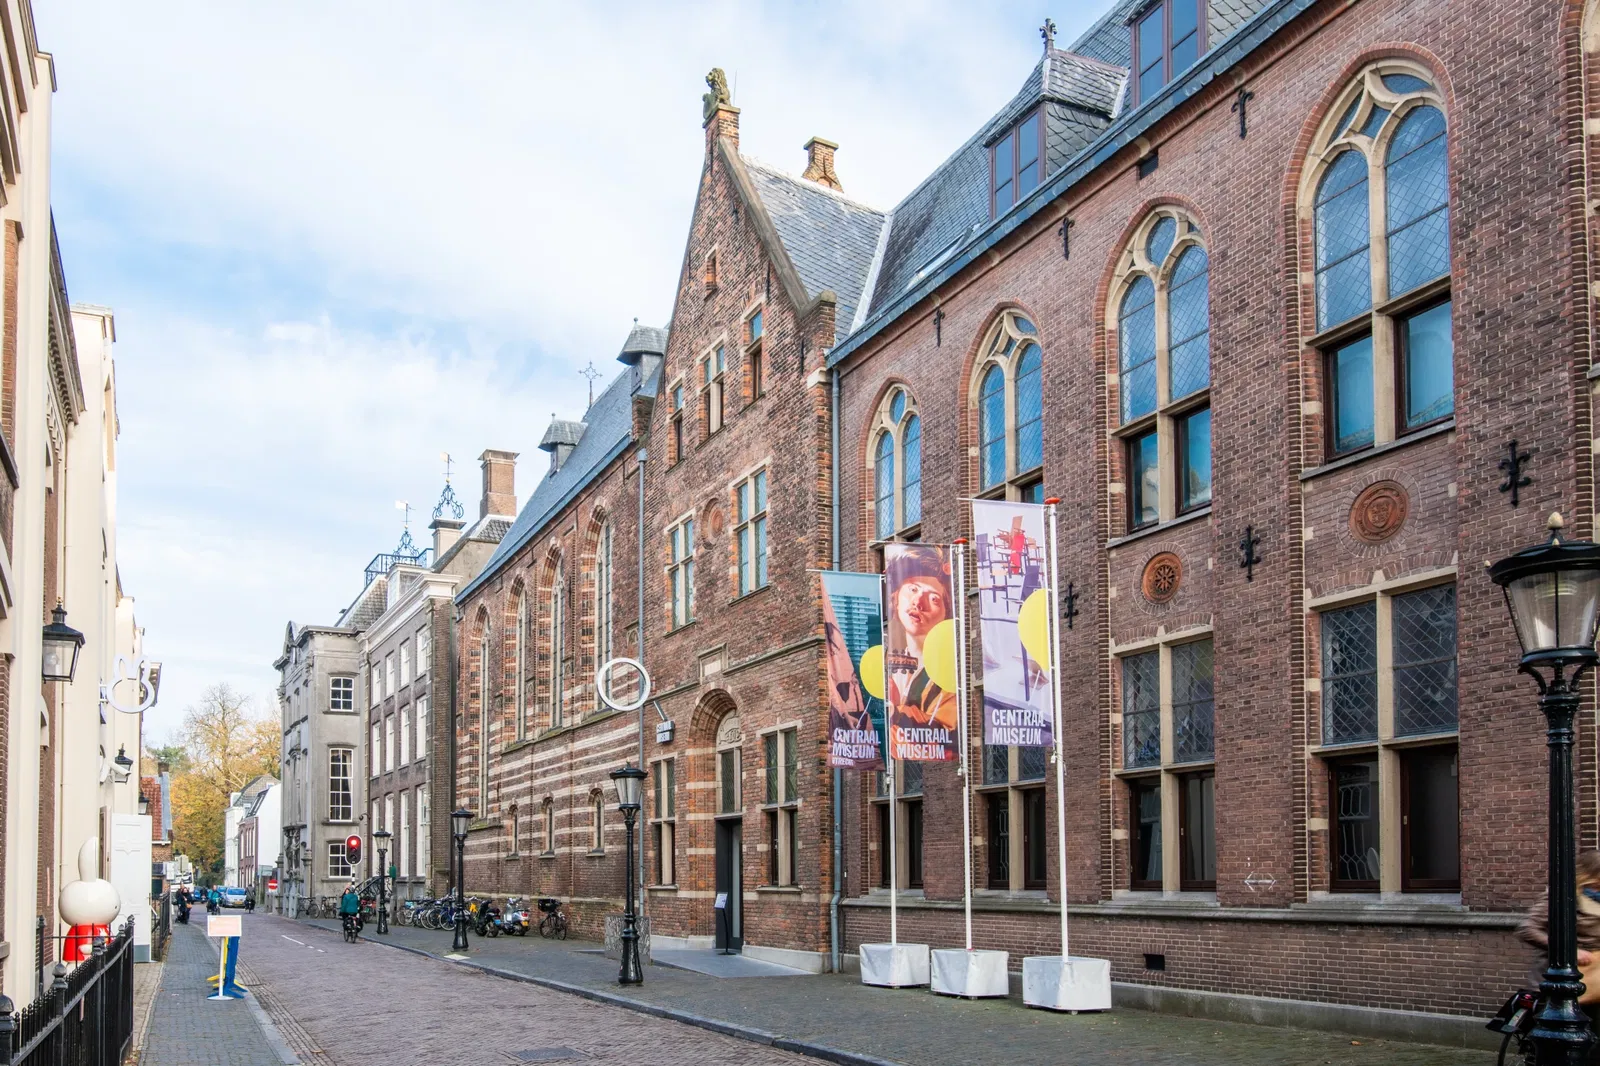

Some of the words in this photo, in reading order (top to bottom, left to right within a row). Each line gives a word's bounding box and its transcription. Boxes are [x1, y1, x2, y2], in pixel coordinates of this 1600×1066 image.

[992, 709, 1046, 727] CENTRAAL
[834, 728, 881, 744] CENTRAAL
[896, 727, 953, 743] CENTRAAL
[992, 727, 1042, 745] MUSEUM
[832, 742, 875, 759] MUSEUM
[896, 743, 945, 760] MUSEUM
